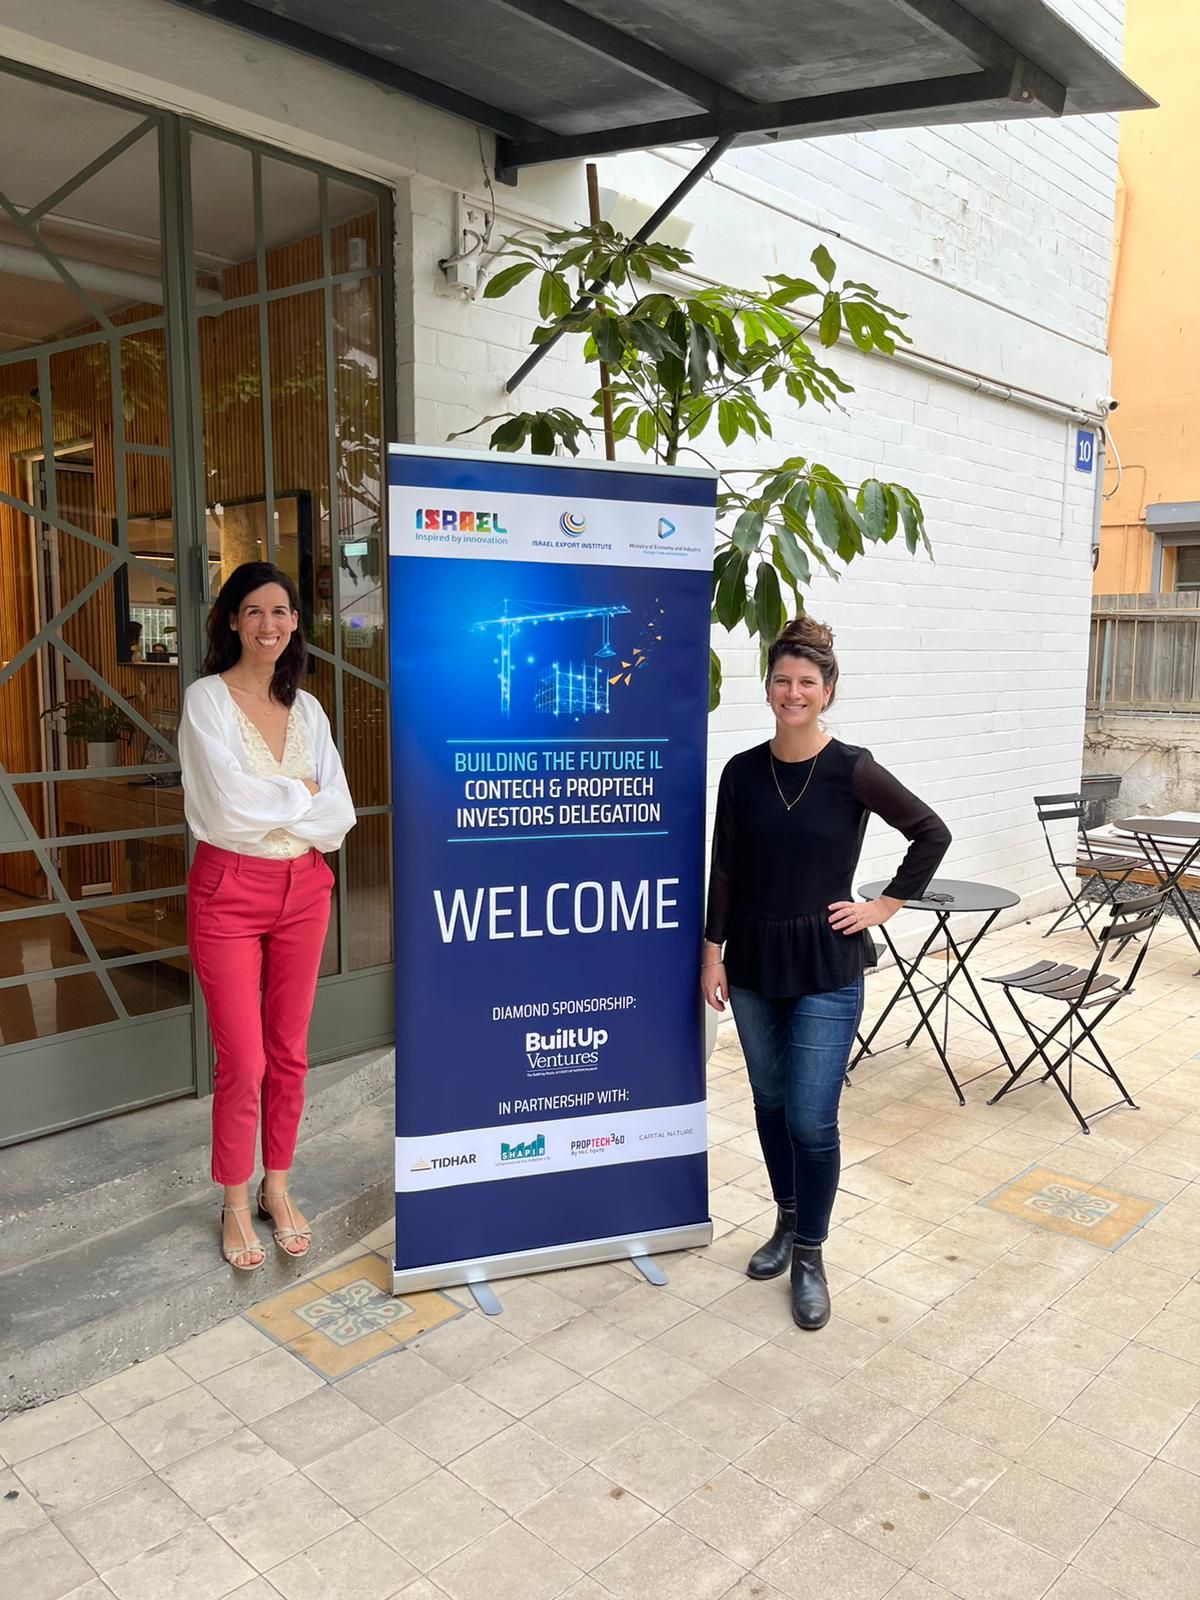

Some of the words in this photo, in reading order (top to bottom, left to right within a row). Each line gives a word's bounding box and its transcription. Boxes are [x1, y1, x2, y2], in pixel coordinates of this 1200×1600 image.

[1079, 440, 1091, 463] 10
[416, 509, 508, 534] ISRAEL
[415, 533, 450, 543] Inspired
[451, 534, 462, 544] by
[463, 535, 508, 545] innovation
[532, 540, 554, 548] ISRAEL
[555, 541, 580, 549] EXPORT
[581, 543, 613, 551] INSTITUTE
[454, 751, 538, 773] BUILDING
[542, 751, 575, 771] THE
[580, 750, 646, 771] FUTURE
[650, 750, 664, 770] IL
[465, 779, 544, 801] CONTECH
[549, 778, 562, 798] &
[566, 777, 654, 798] PROPTECH
[456, 805, 554, 828] INVESTORS
[559, 802, 661, 825] DELEGATION
[433, 877, 680, 944] WELCOME
[492, 1002, 549, 1021] DIAMOND
[552, 995, 637, 1016] SPONSORSHIP:
[526, 1051, 599, 1069] Ventures
[499, 1101, 511, 1115] IN
[514, 1092, 595, 1114] PARTNERSHIP
[597, 1088, 630, 1105] WITH:
[638, 1132, 665, 1141] CAPITAL
[667, 1128, 694, 1138] NATURE
[431, 1153, 477, 1170] TIDHAR
[502, 1147, 545, 1160] SHAPIR
